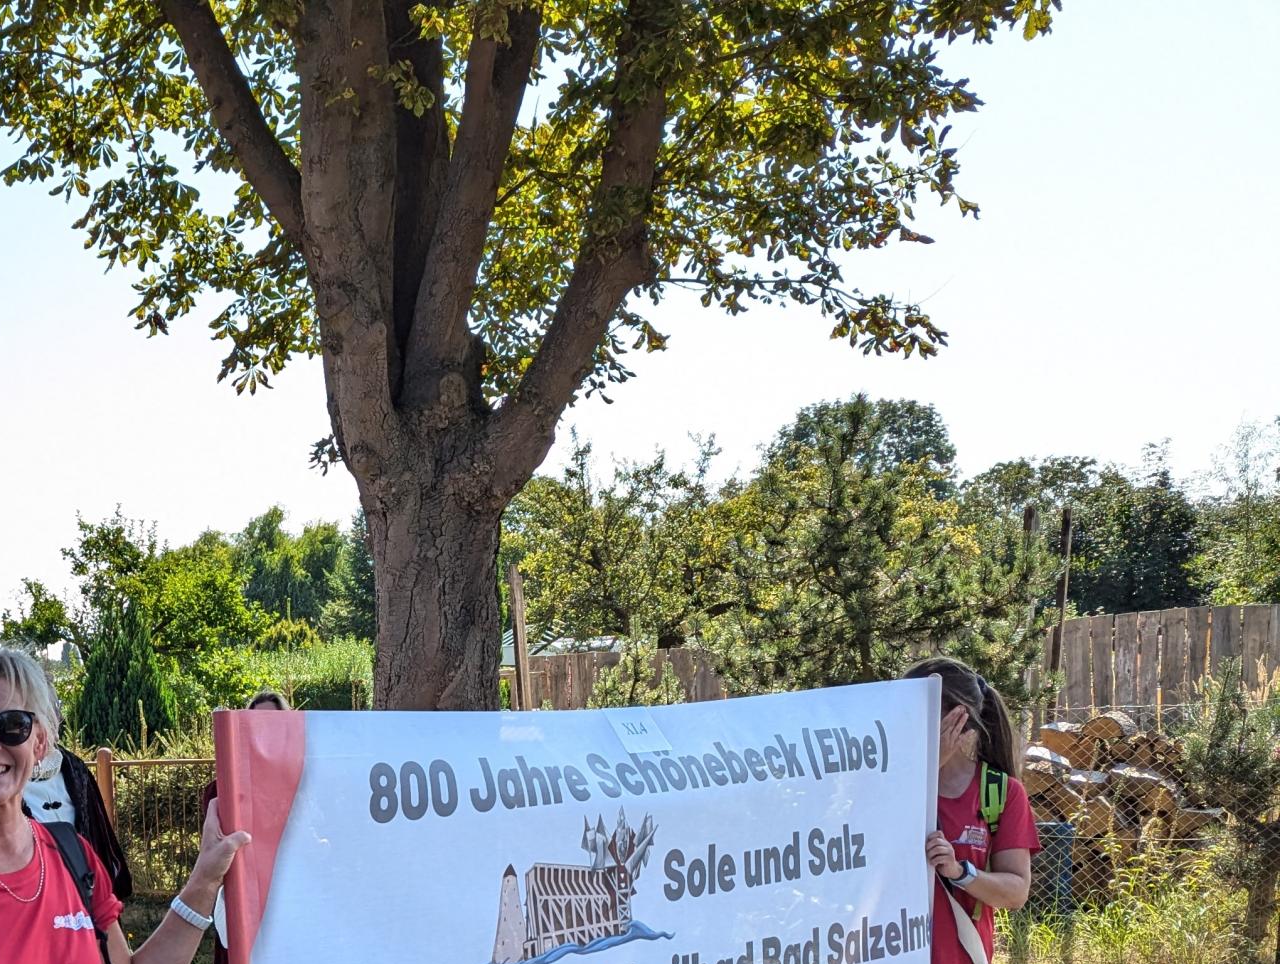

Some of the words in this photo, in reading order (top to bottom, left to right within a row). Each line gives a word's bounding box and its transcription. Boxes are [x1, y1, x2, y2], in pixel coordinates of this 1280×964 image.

[369, 758, 458, 824] 800
[469, 754, 591, 814] Jahre
[585, 732, 812, 800] Schönebeck
[803, 719, 890, 781] (Elbe)
[663, 843, 737, 902] Sole
[743, 831, 802, 888] und
[808, 823, 867, 877] Salz
